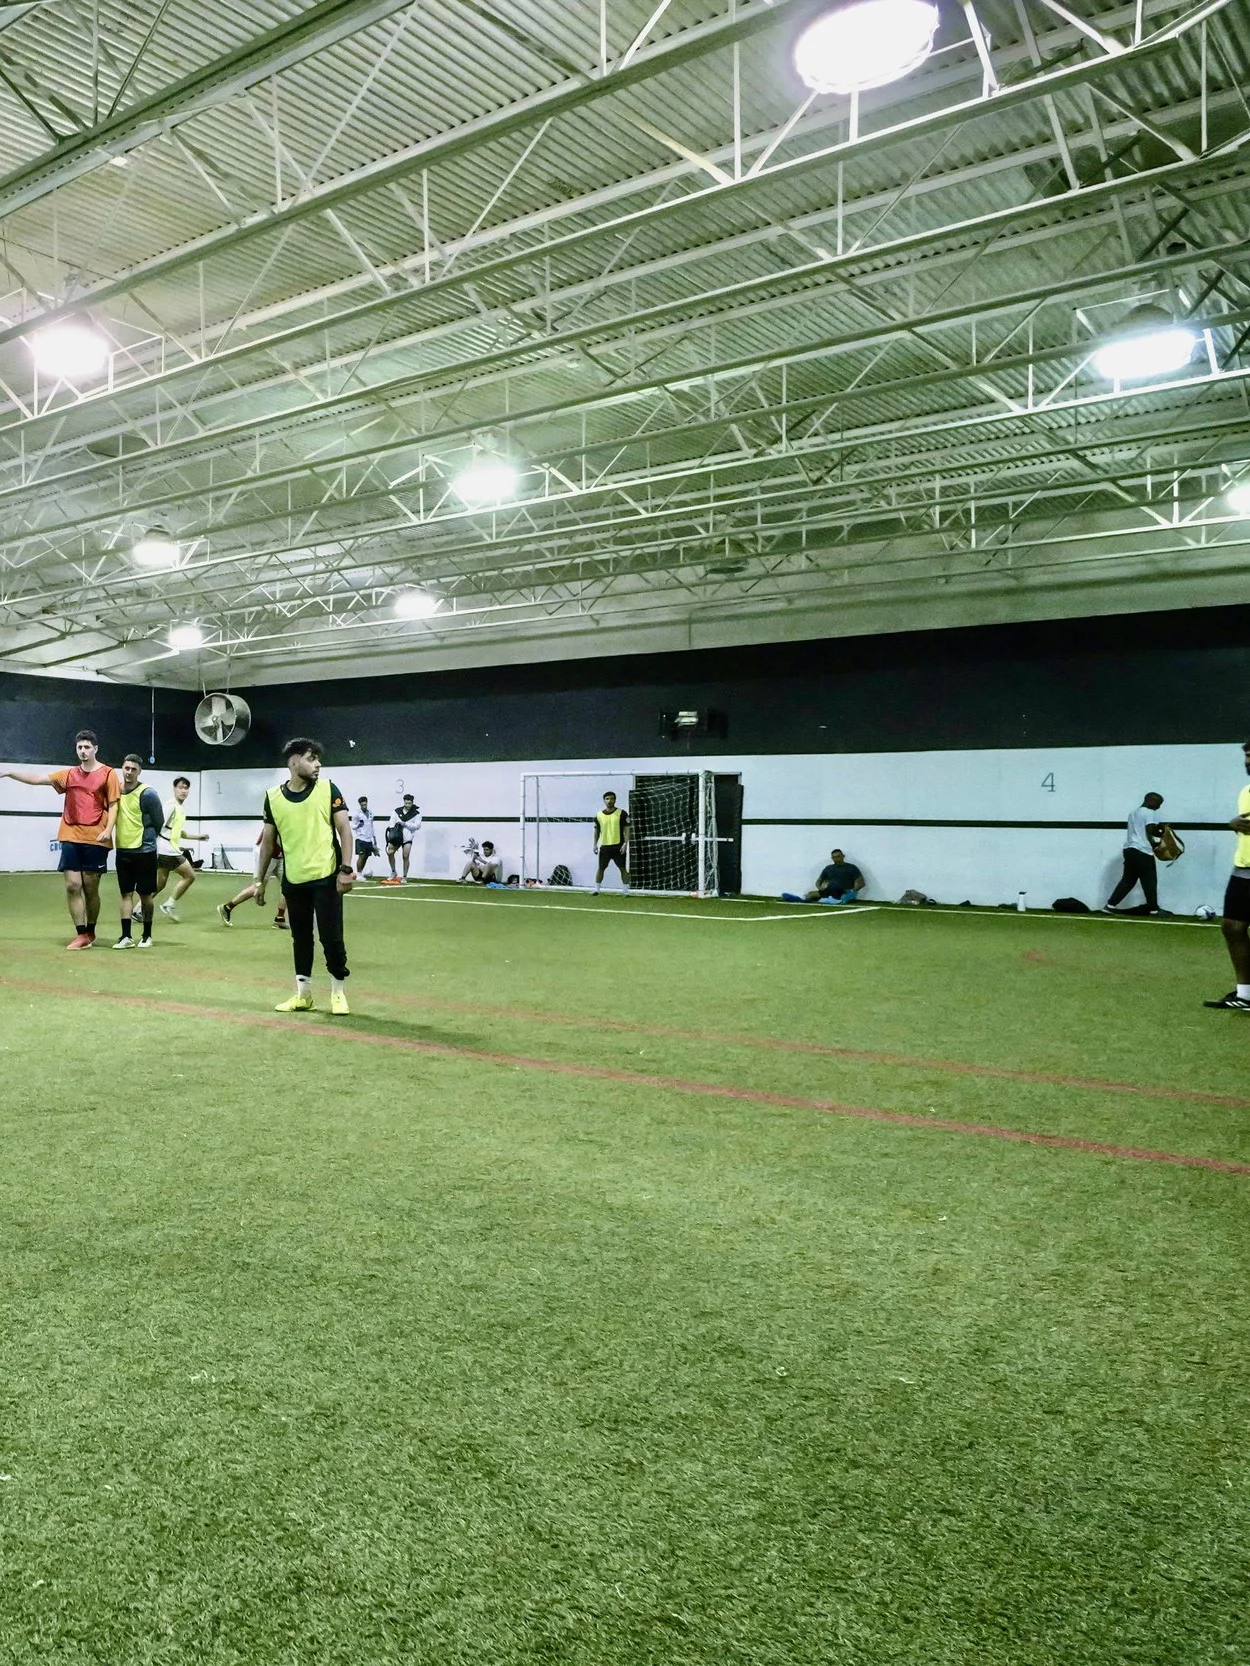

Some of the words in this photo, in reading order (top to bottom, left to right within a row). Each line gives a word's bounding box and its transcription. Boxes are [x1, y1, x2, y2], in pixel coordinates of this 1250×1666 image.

[216, 781, 223, 794] 1
[395, 778, 405, 794] 3
[1041, 772, 1056, 792] 4
